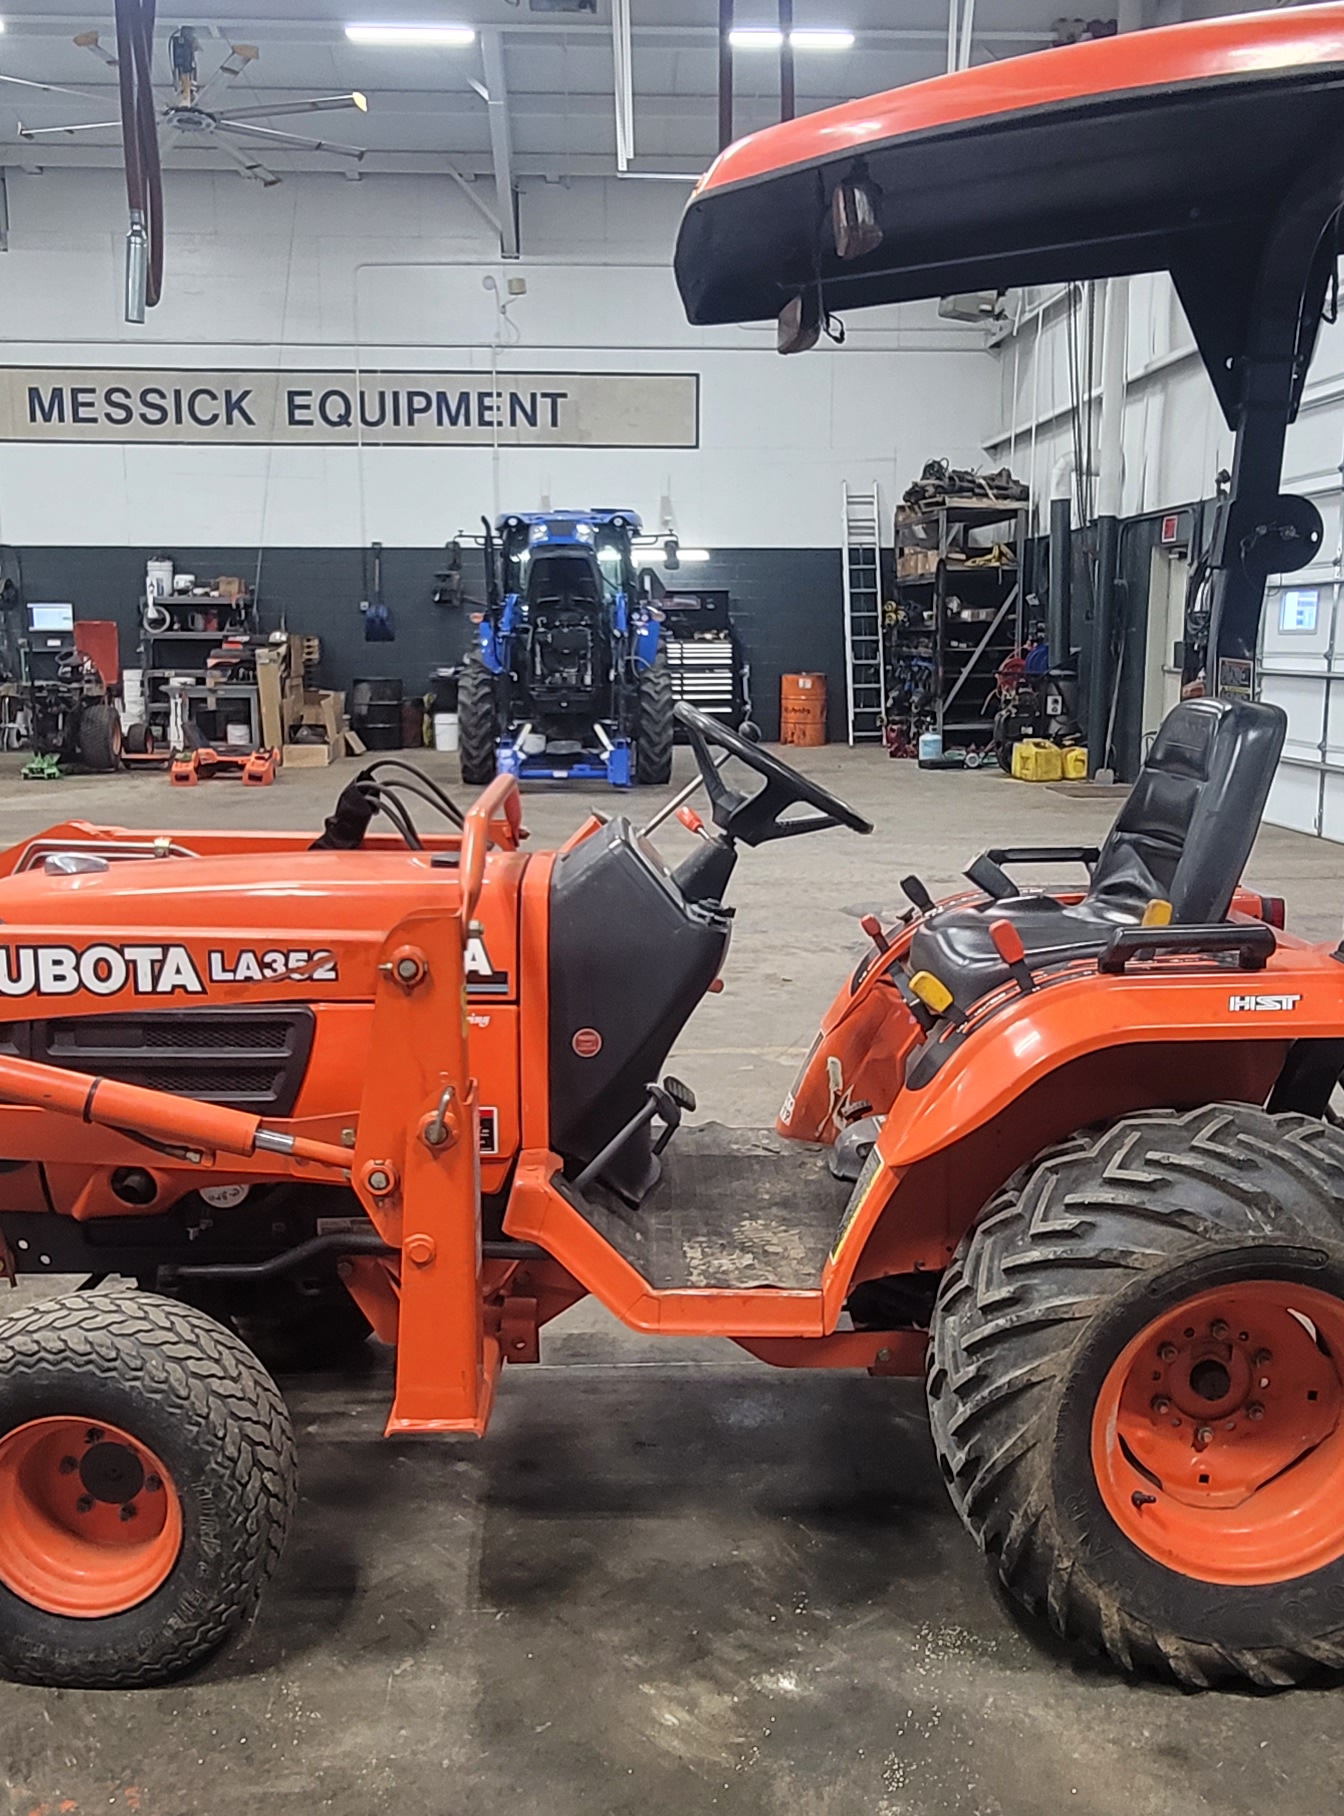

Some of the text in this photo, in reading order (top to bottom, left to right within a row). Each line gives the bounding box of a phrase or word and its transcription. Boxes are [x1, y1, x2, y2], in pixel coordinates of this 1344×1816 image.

[27, 386, 569, 428] MESSICK EQUIPMENT
[209, 949, 338, 982] LA352
[1228, 994, 1302, 1012] HST
